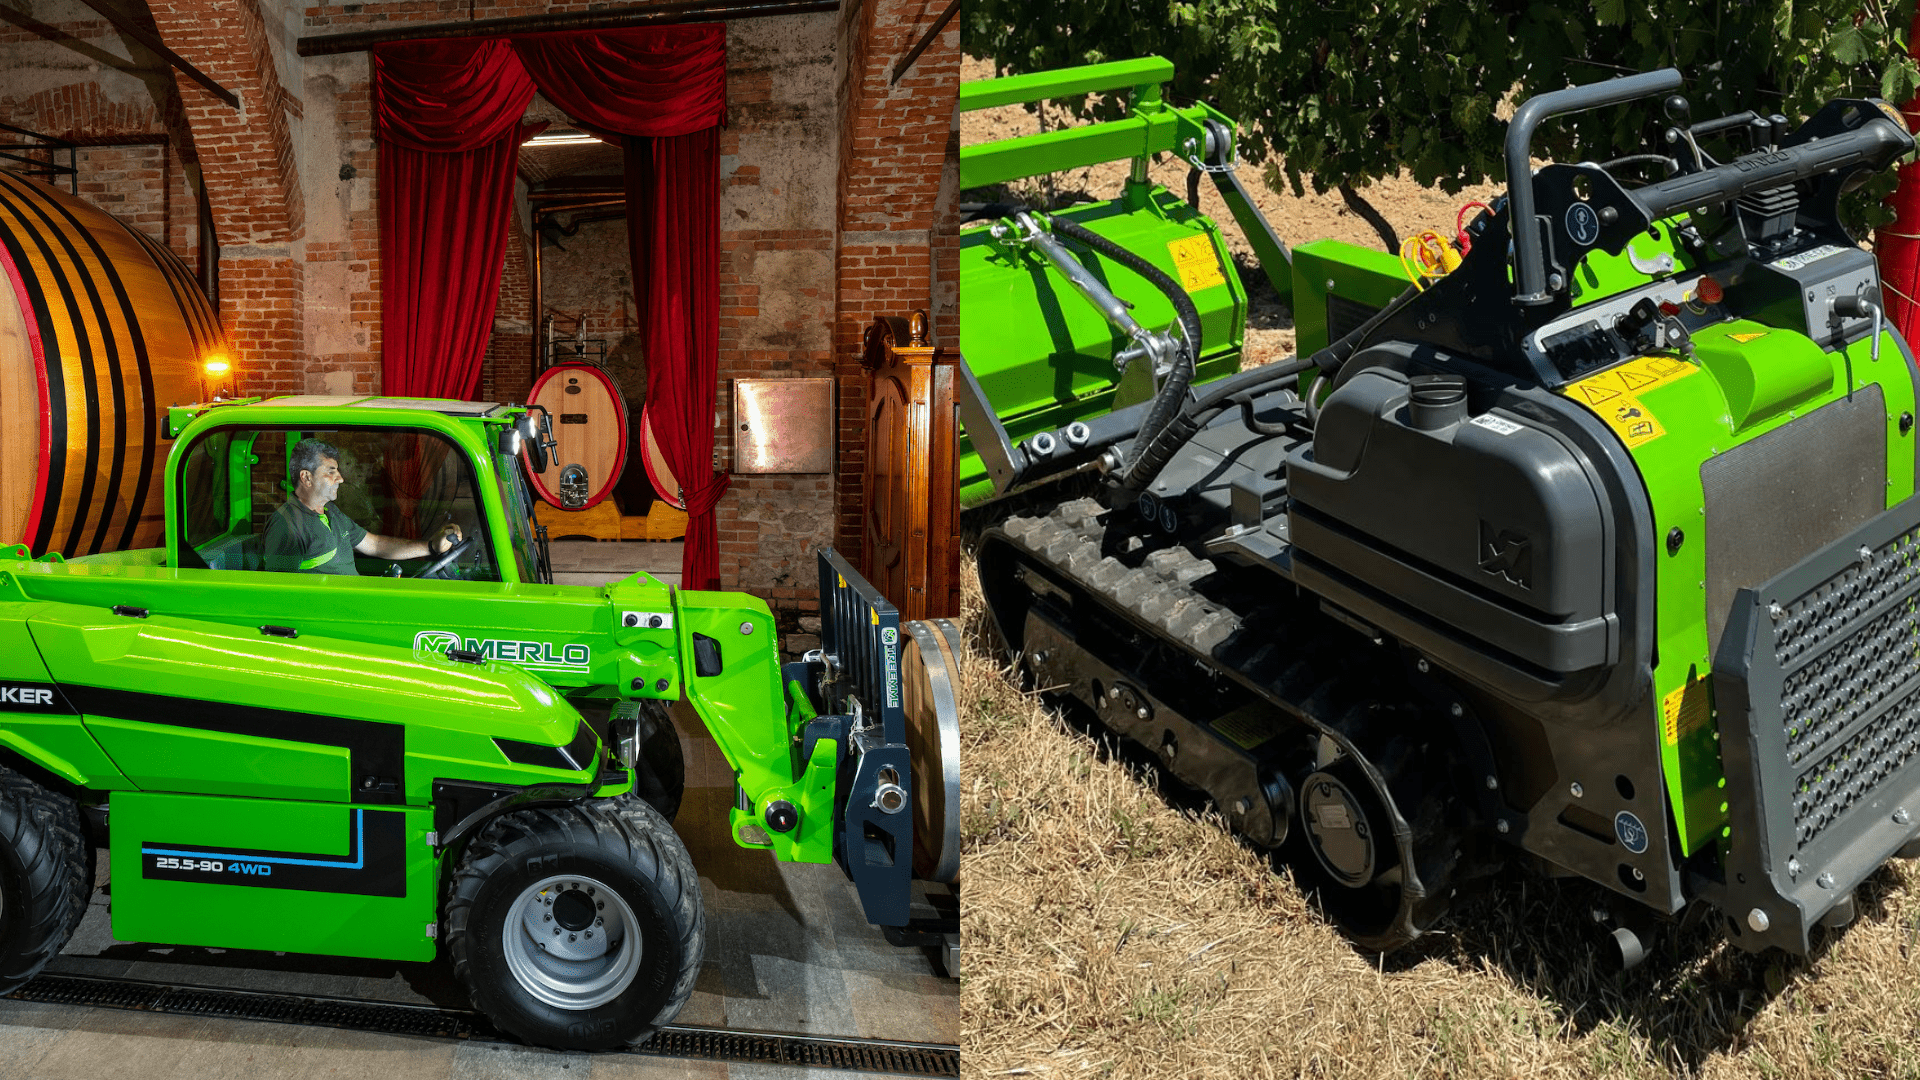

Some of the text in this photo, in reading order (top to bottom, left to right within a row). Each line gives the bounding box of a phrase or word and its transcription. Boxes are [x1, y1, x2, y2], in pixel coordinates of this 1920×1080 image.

[464, 637, 591, 666] MERLO
[0, 686, 54, 705] KER
[156, 857, 272, 876] 25.5-90 4WD
